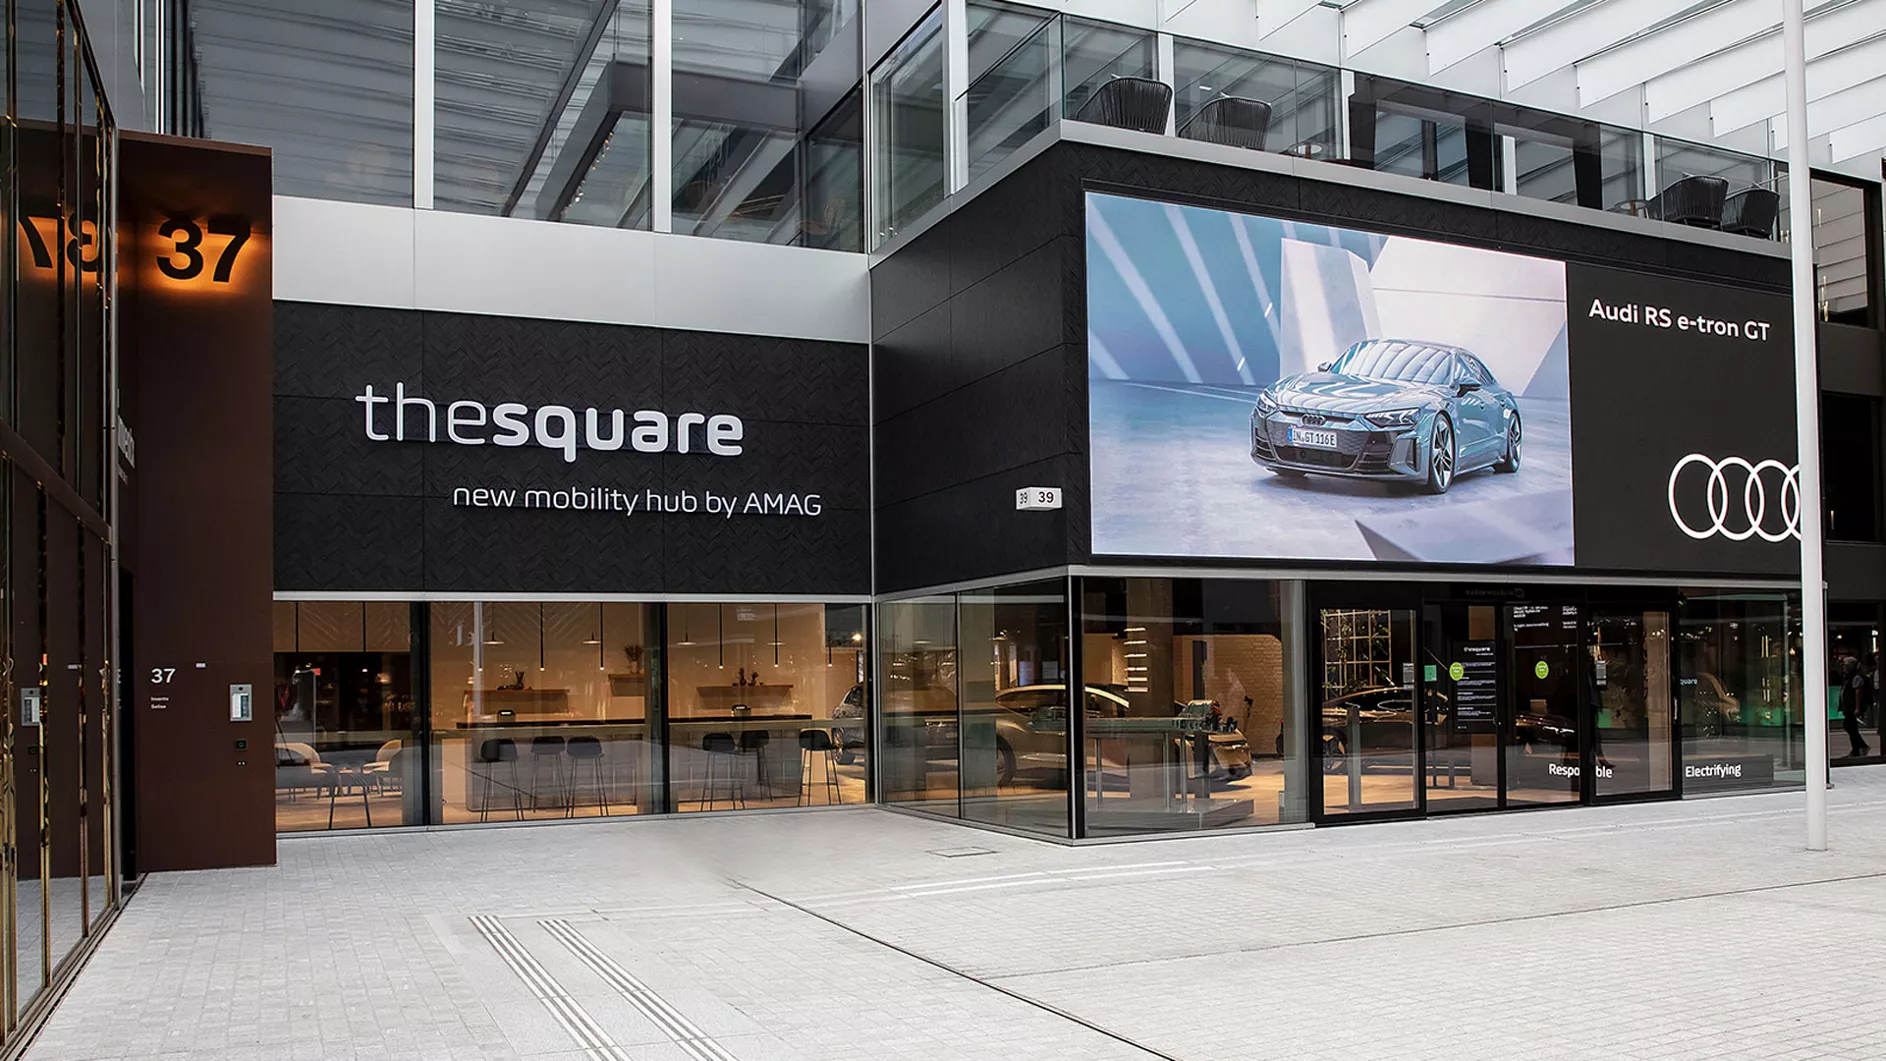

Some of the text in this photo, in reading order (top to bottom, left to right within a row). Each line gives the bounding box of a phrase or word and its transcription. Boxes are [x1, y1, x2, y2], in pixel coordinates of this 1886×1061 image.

[156, 216, 252, 283] 37
[1588, 299, 1770, 342] Audi RS e-tron GT
[355, 381, 745, 463] thesquare
[453, 486, 823, 520] new mobility hub by AMAG
[1038, 491, 1054, 503] 39
[150, 668, 176, 683] 37
[1685, 764, 1742, 778] Electrifying
